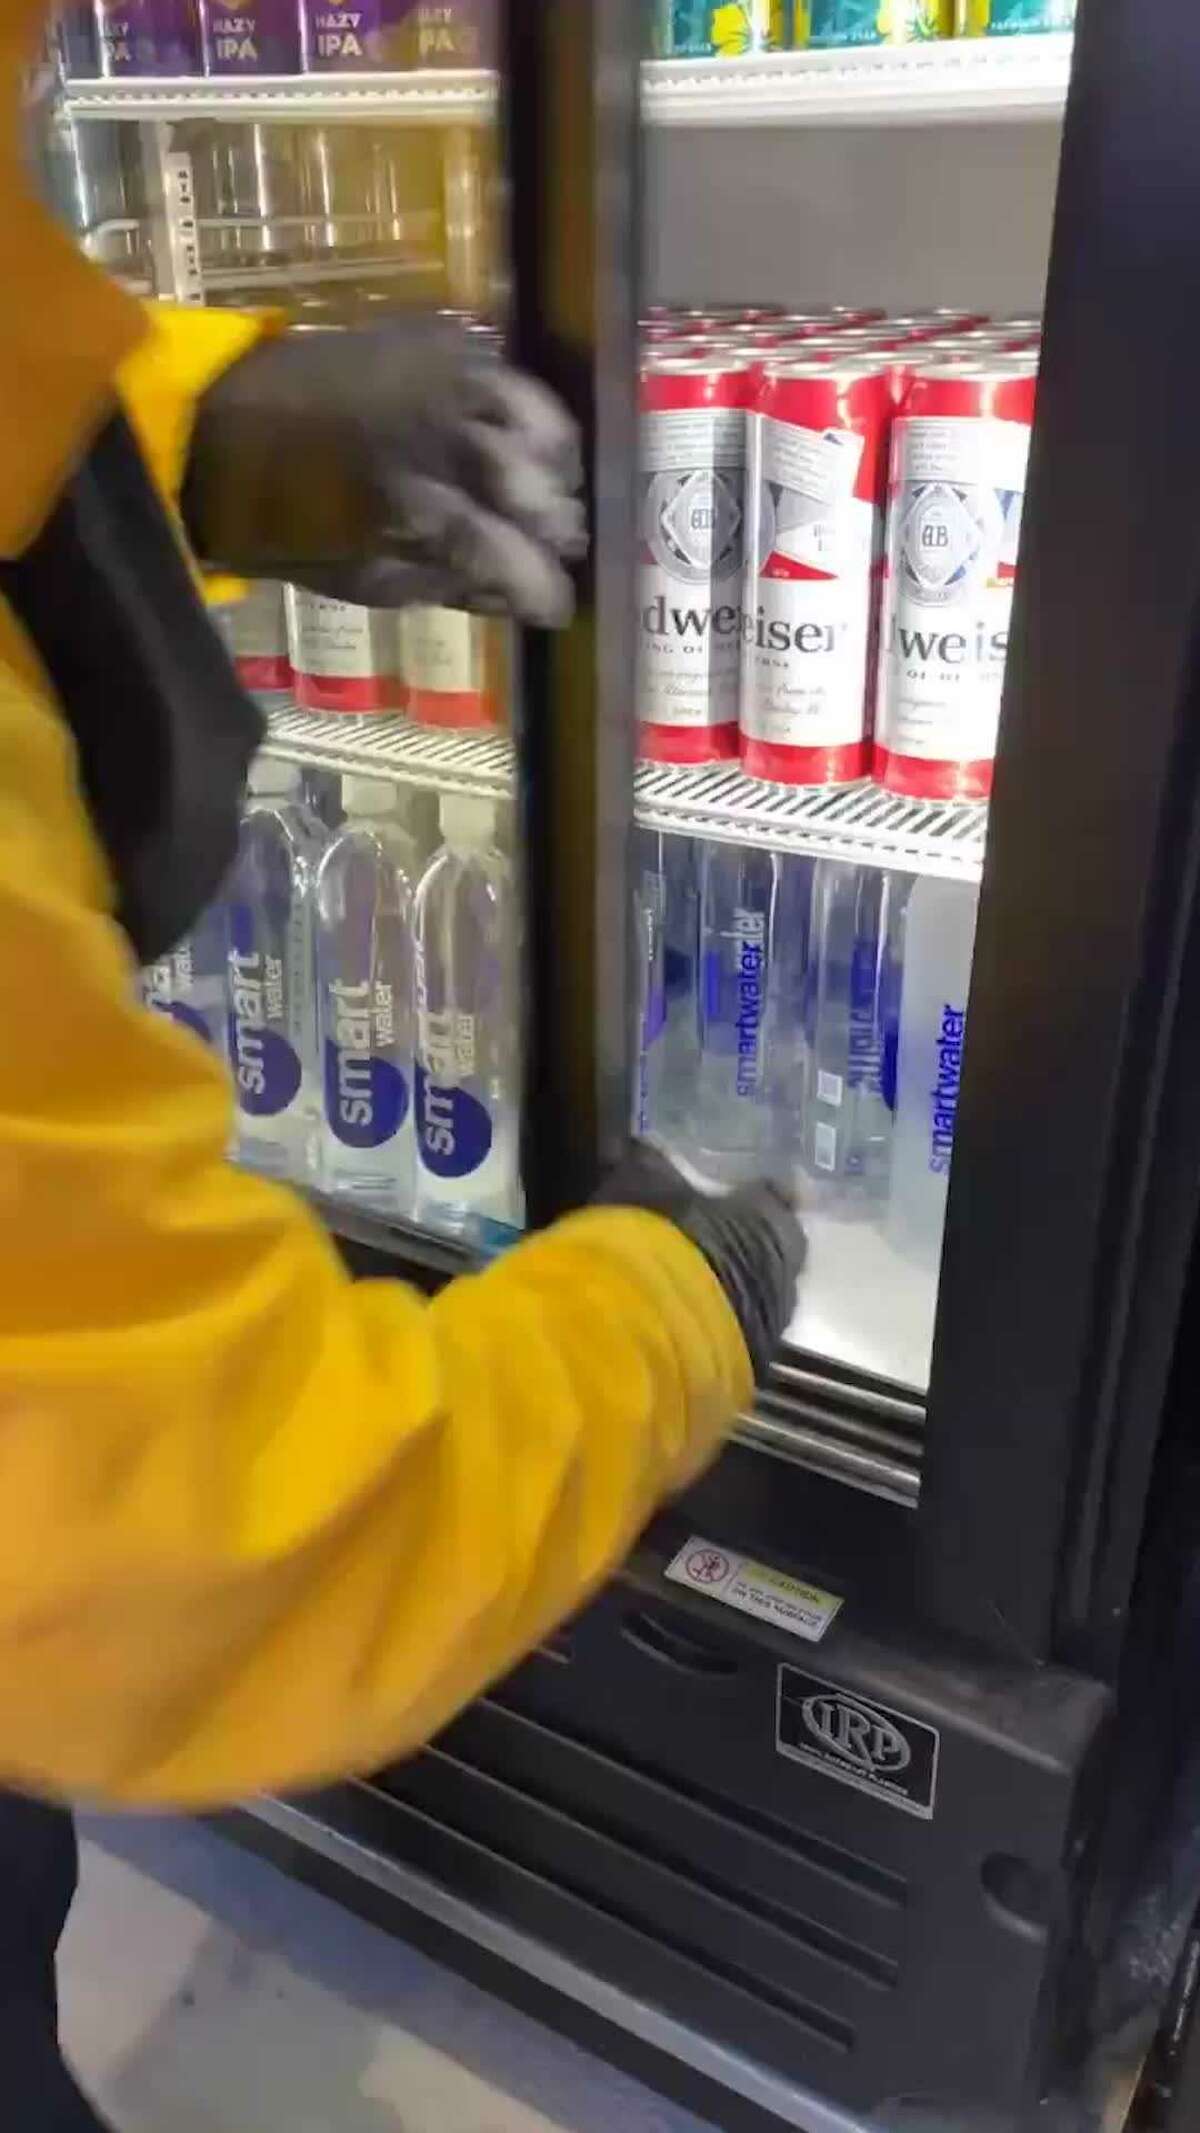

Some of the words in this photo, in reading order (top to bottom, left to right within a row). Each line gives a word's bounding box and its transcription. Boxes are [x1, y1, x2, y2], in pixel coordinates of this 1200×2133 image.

[215, 38, 258, 60] IPA
[317, 33, 363, 57] IPA
[228, 947, 266, 1094] smart
[329, 978, 373, 1126] smart
[736, 941, 763, 1097] smartwater
[928, 1003, 964, 1175] smartwater
